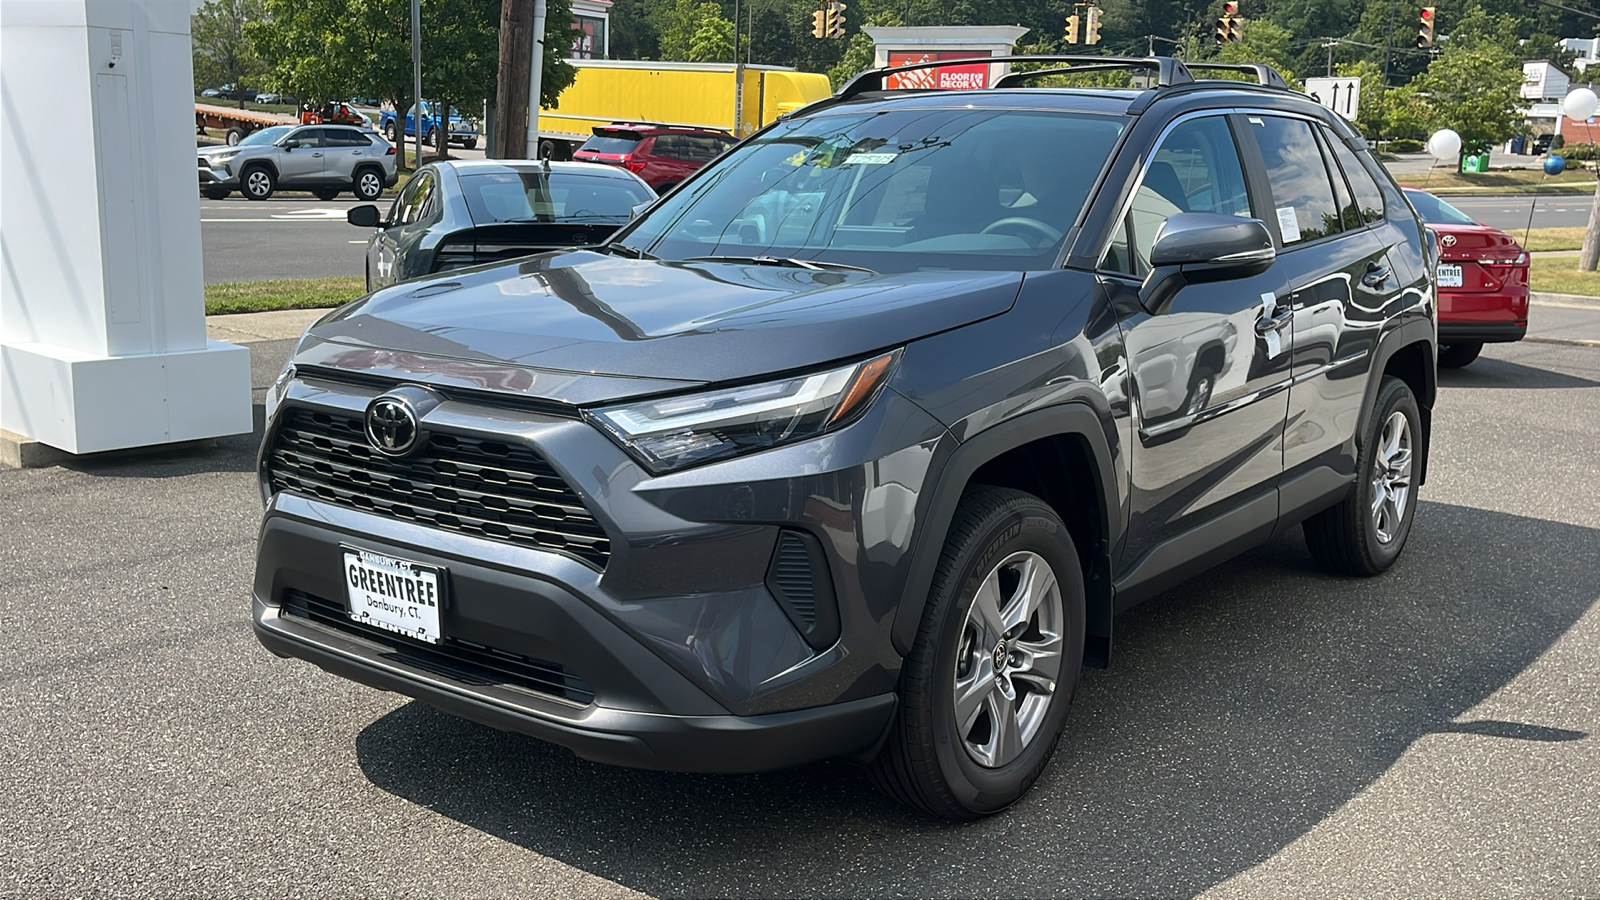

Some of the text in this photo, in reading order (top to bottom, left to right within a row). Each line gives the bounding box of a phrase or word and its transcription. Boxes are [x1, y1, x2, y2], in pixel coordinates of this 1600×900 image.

[941, 73, 969, 81] FLOOR
[976, 523, 1020, 576] MICHELIN
[349, 564, 435, 607] GREENTREE
[366, 595, 421, 619] Danbury, CT.
[350, 614, 437, 644] GREENTREE
